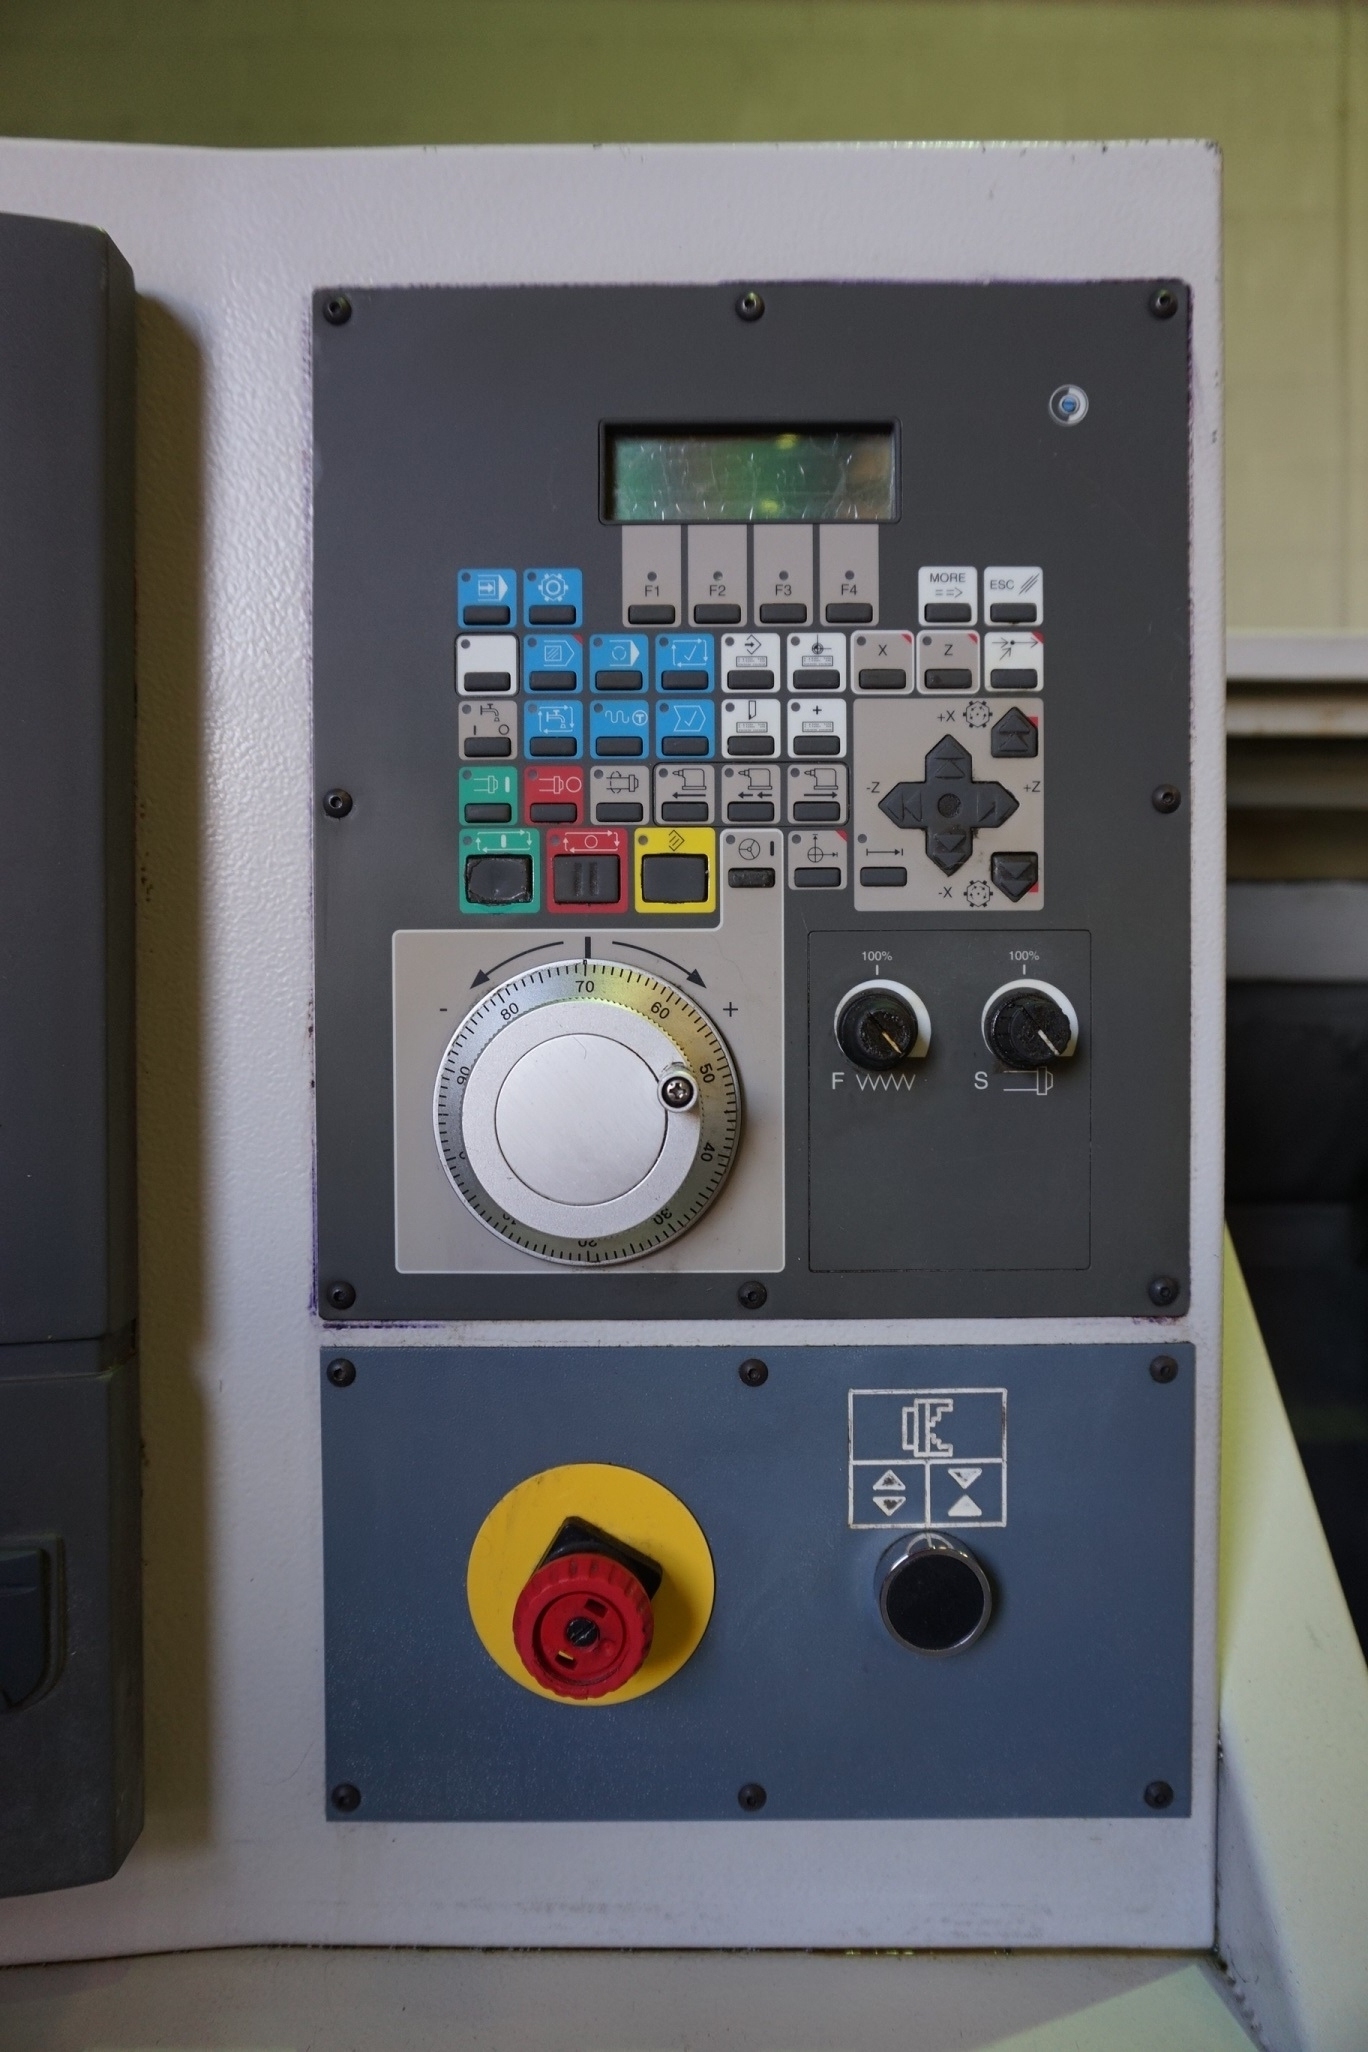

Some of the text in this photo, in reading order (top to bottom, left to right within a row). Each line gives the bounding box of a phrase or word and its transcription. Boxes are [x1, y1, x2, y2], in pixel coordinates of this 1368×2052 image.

[929, 572, 966, 584] MORE
[989, 578, 1015, 591] ESC
[644, 584, 660, 597] F1
[709, 584, 726, 597] F2
[775, 583, 792, 596] F3
[841, 583, 858, 596] F4
[878, 644, 888, 657] X
[944, 644, 954, 657] Z
[937, 710, 956, 722] +X
[866, 781, 880, 794] -Z
[1023, 781, 1041, 794] +Z
[938, 887, 952, 899] -X
[861, 951, 893, 962] 100%
[1008, 950, 1040, 962] 100%
[575, 980, 596, 994] 70
[500, 1002, 520, 1021] 80
[650, 1001, 670, 1020] 60
[456, 1065, 470, 1086] 90
[699, 1062, 716, 1084] 50
[831, 1072, 845, 1090] F
[974, 1071, 989, 1090] S
[700, 1141, 716, 1162] 40
[652, 1207, 673, 1226] 30
